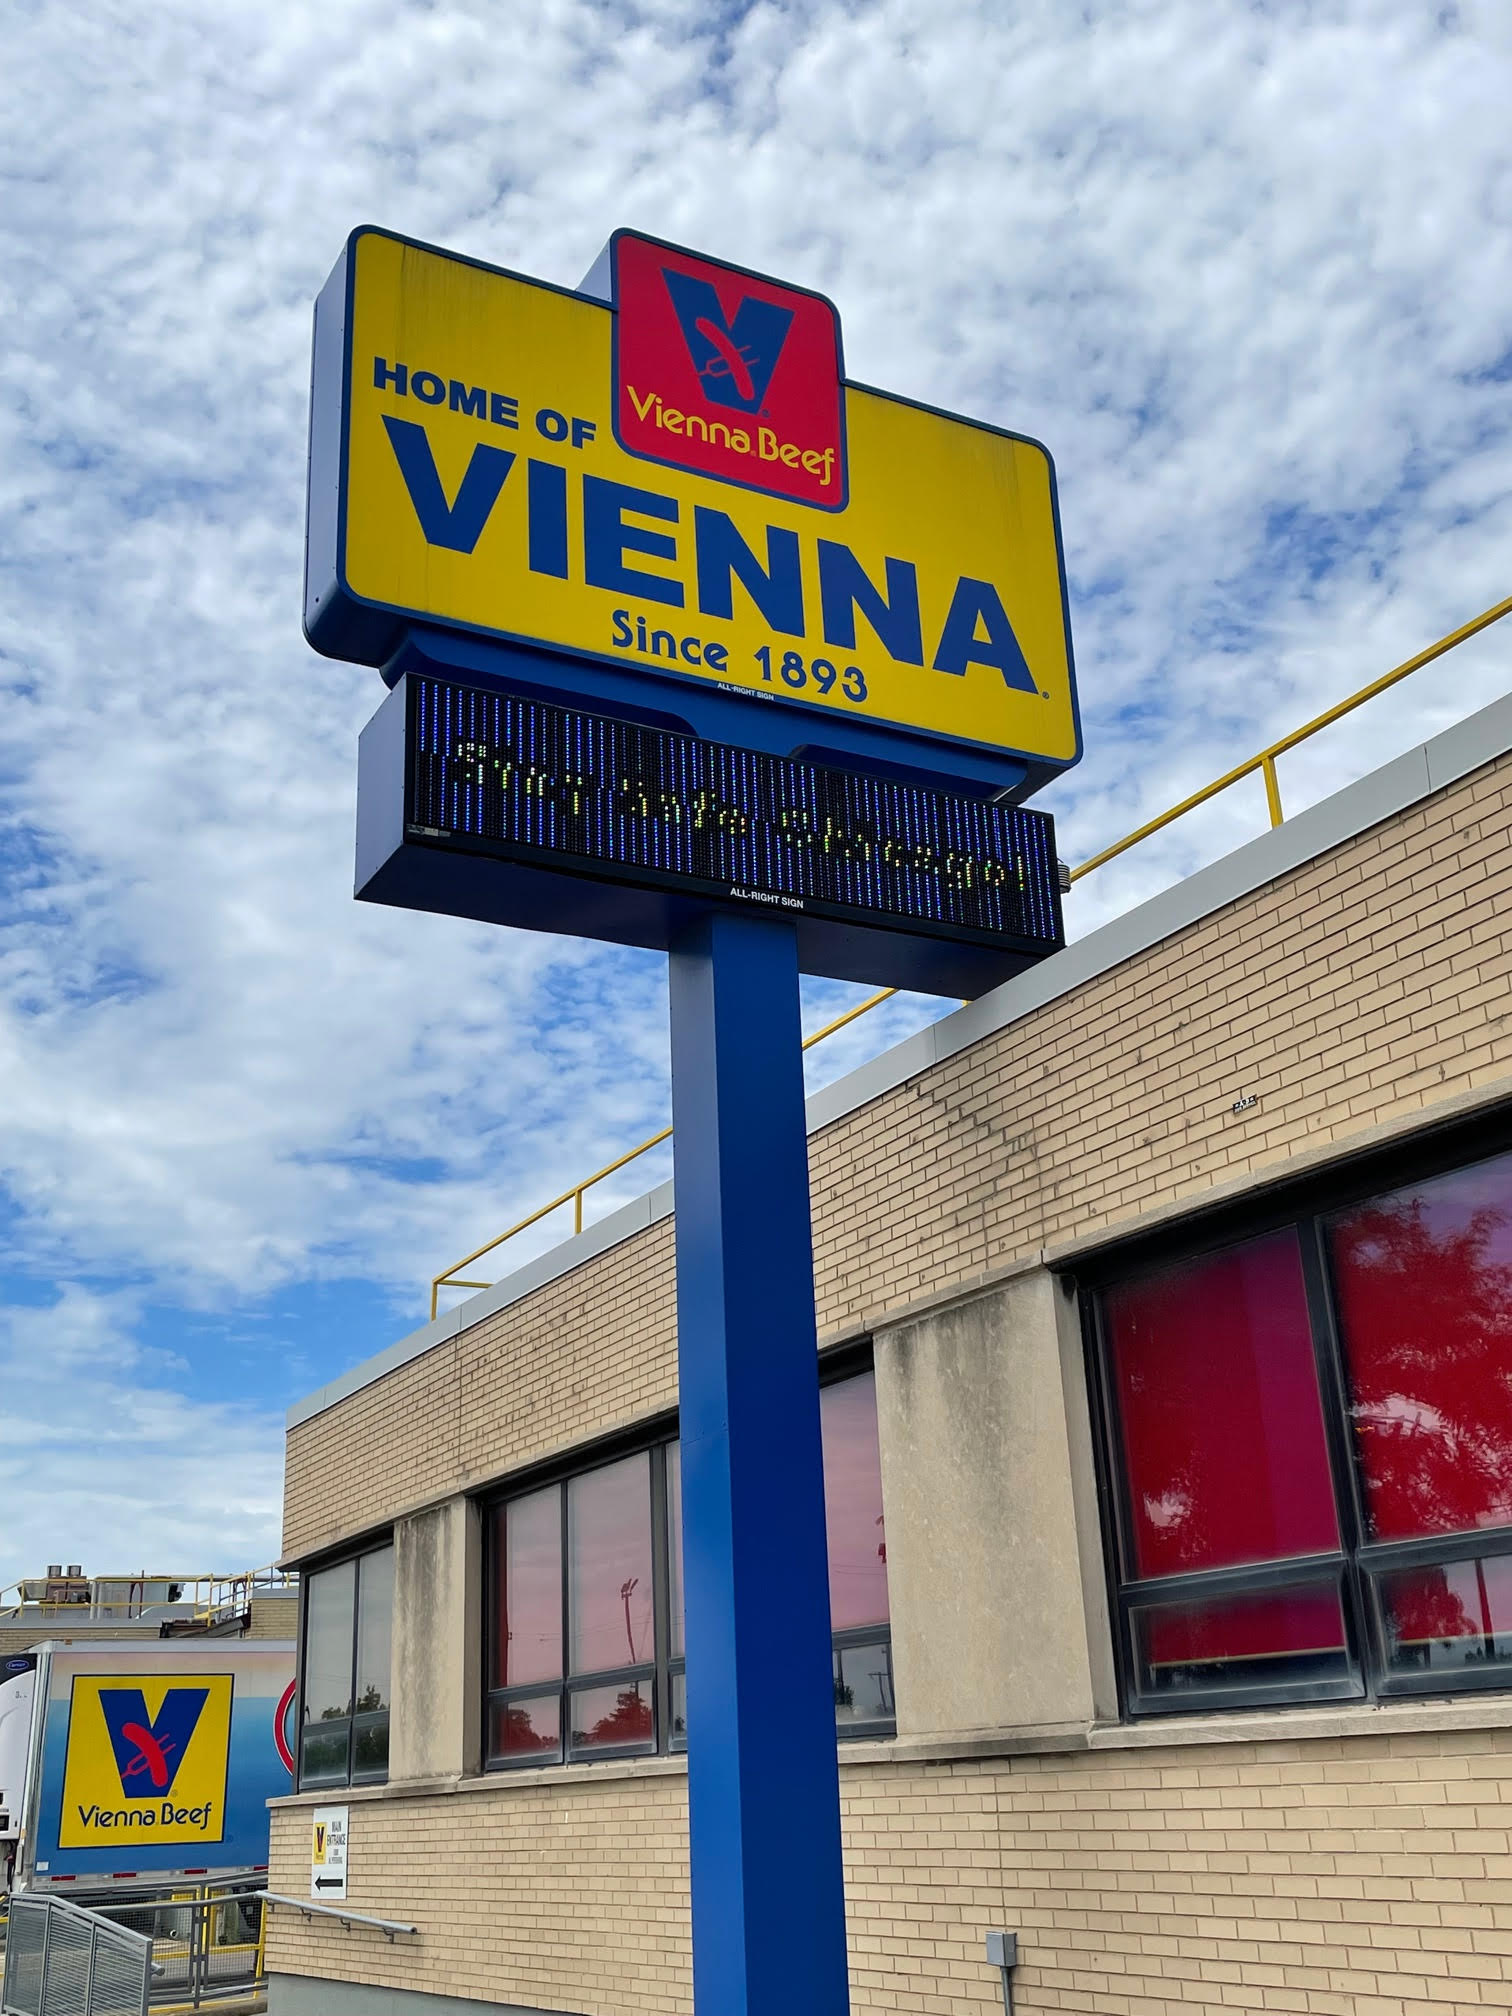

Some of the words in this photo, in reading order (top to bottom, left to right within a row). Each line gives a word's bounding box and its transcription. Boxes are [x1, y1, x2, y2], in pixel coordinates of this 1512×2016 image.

[661, 267, 795, 415] V
[374, 357, 519, 428] HOME
[535, 409, 596, 449] OF
[627, 385, 751, 455] Vienna
[758, 425, 836, 487] Beef
[381, 414, 1040, 695] VIENNA
[611, 609, 729, 673] Since
[755, 646, 869, 703] 1893
[717, 682, 756, 697] ALL-RIGHT
[756, 691, 775, 701] SIGN
[730, 887, 780, 904] ALL-RIGHT
[781, 897, 804, 909] SIGN
[98, 1688, 210, 1799] V
[78, 1805, 155, 1828] Vienna
[161, 1802, 212, 1830] Beef
